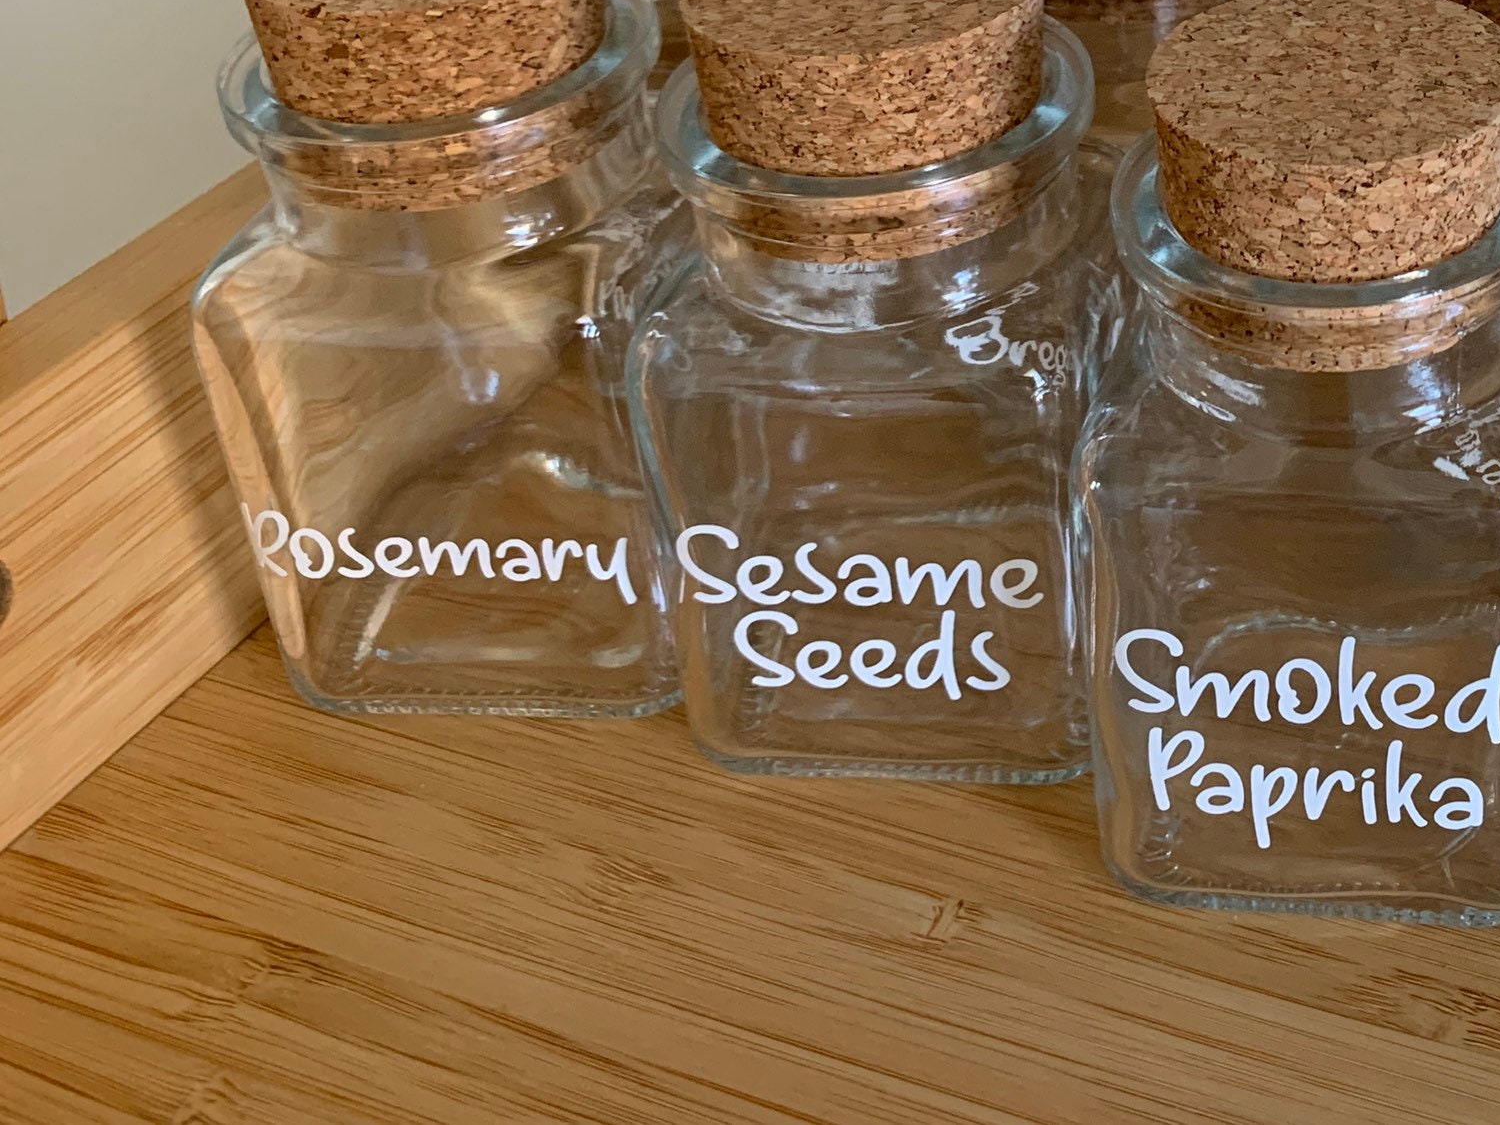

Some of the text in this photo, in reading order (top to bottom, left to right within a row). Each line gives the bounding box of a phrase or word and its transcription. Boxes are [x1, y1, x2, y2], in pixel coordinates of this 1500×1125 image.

[241, 502, 637, 605] Rosemary
[676, 524, 1044, 608] Sesame
[733, 610, 1011, 700] Seeds
[1147, 727, 1485, 849] Paprika
